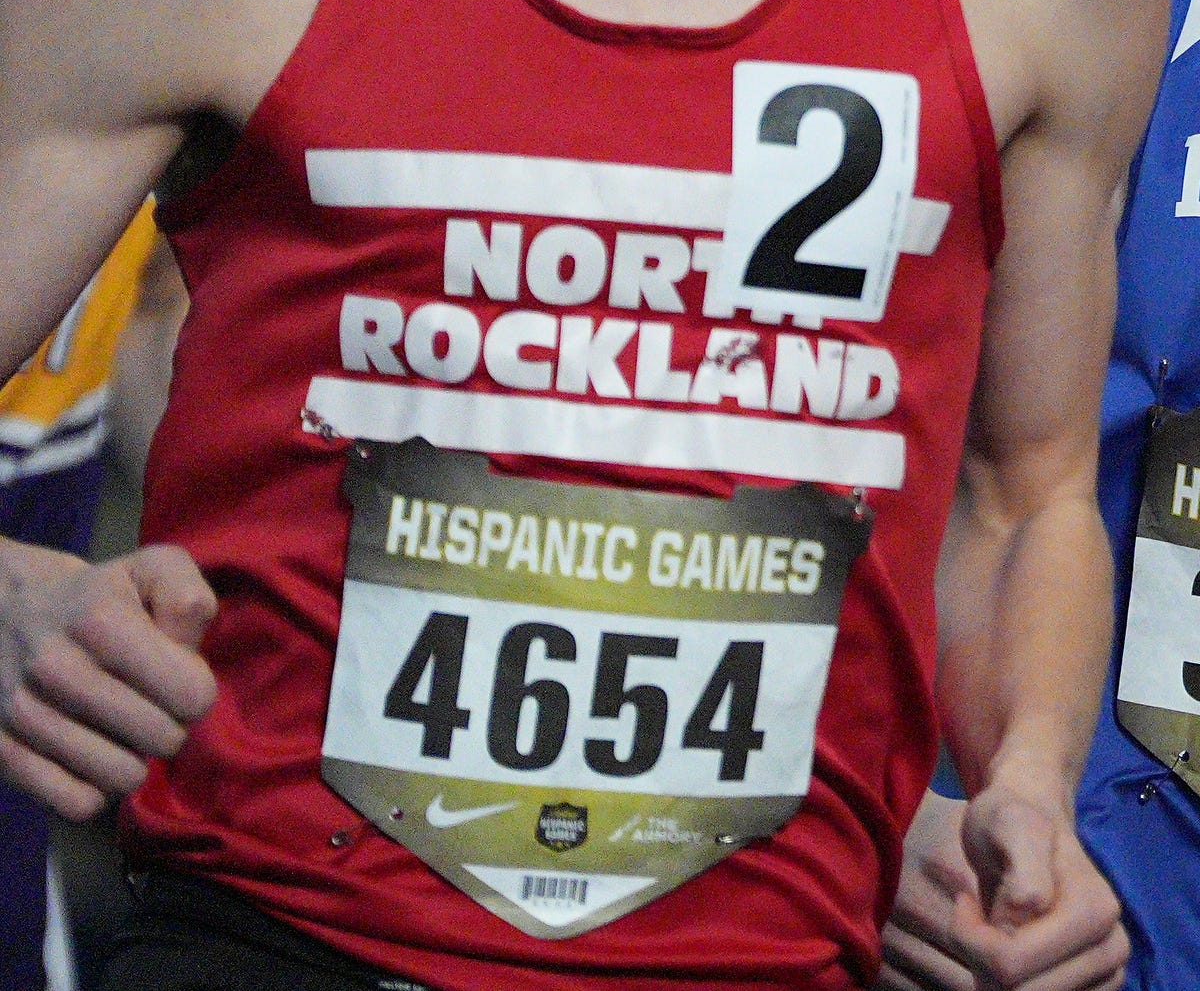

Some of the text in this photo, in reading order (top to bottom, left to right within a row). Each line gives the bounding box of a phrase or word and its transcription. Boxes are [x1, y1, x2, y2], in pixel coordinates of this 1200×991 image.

[741, 84, 884, 300] 2
[444, 218, 823, 331] NORT
[338, 294, 900, 421] ROCKLAND
[386, 495, 825, 597] HISPANIC GAMES
[383, 611, 766, 783] 4654
